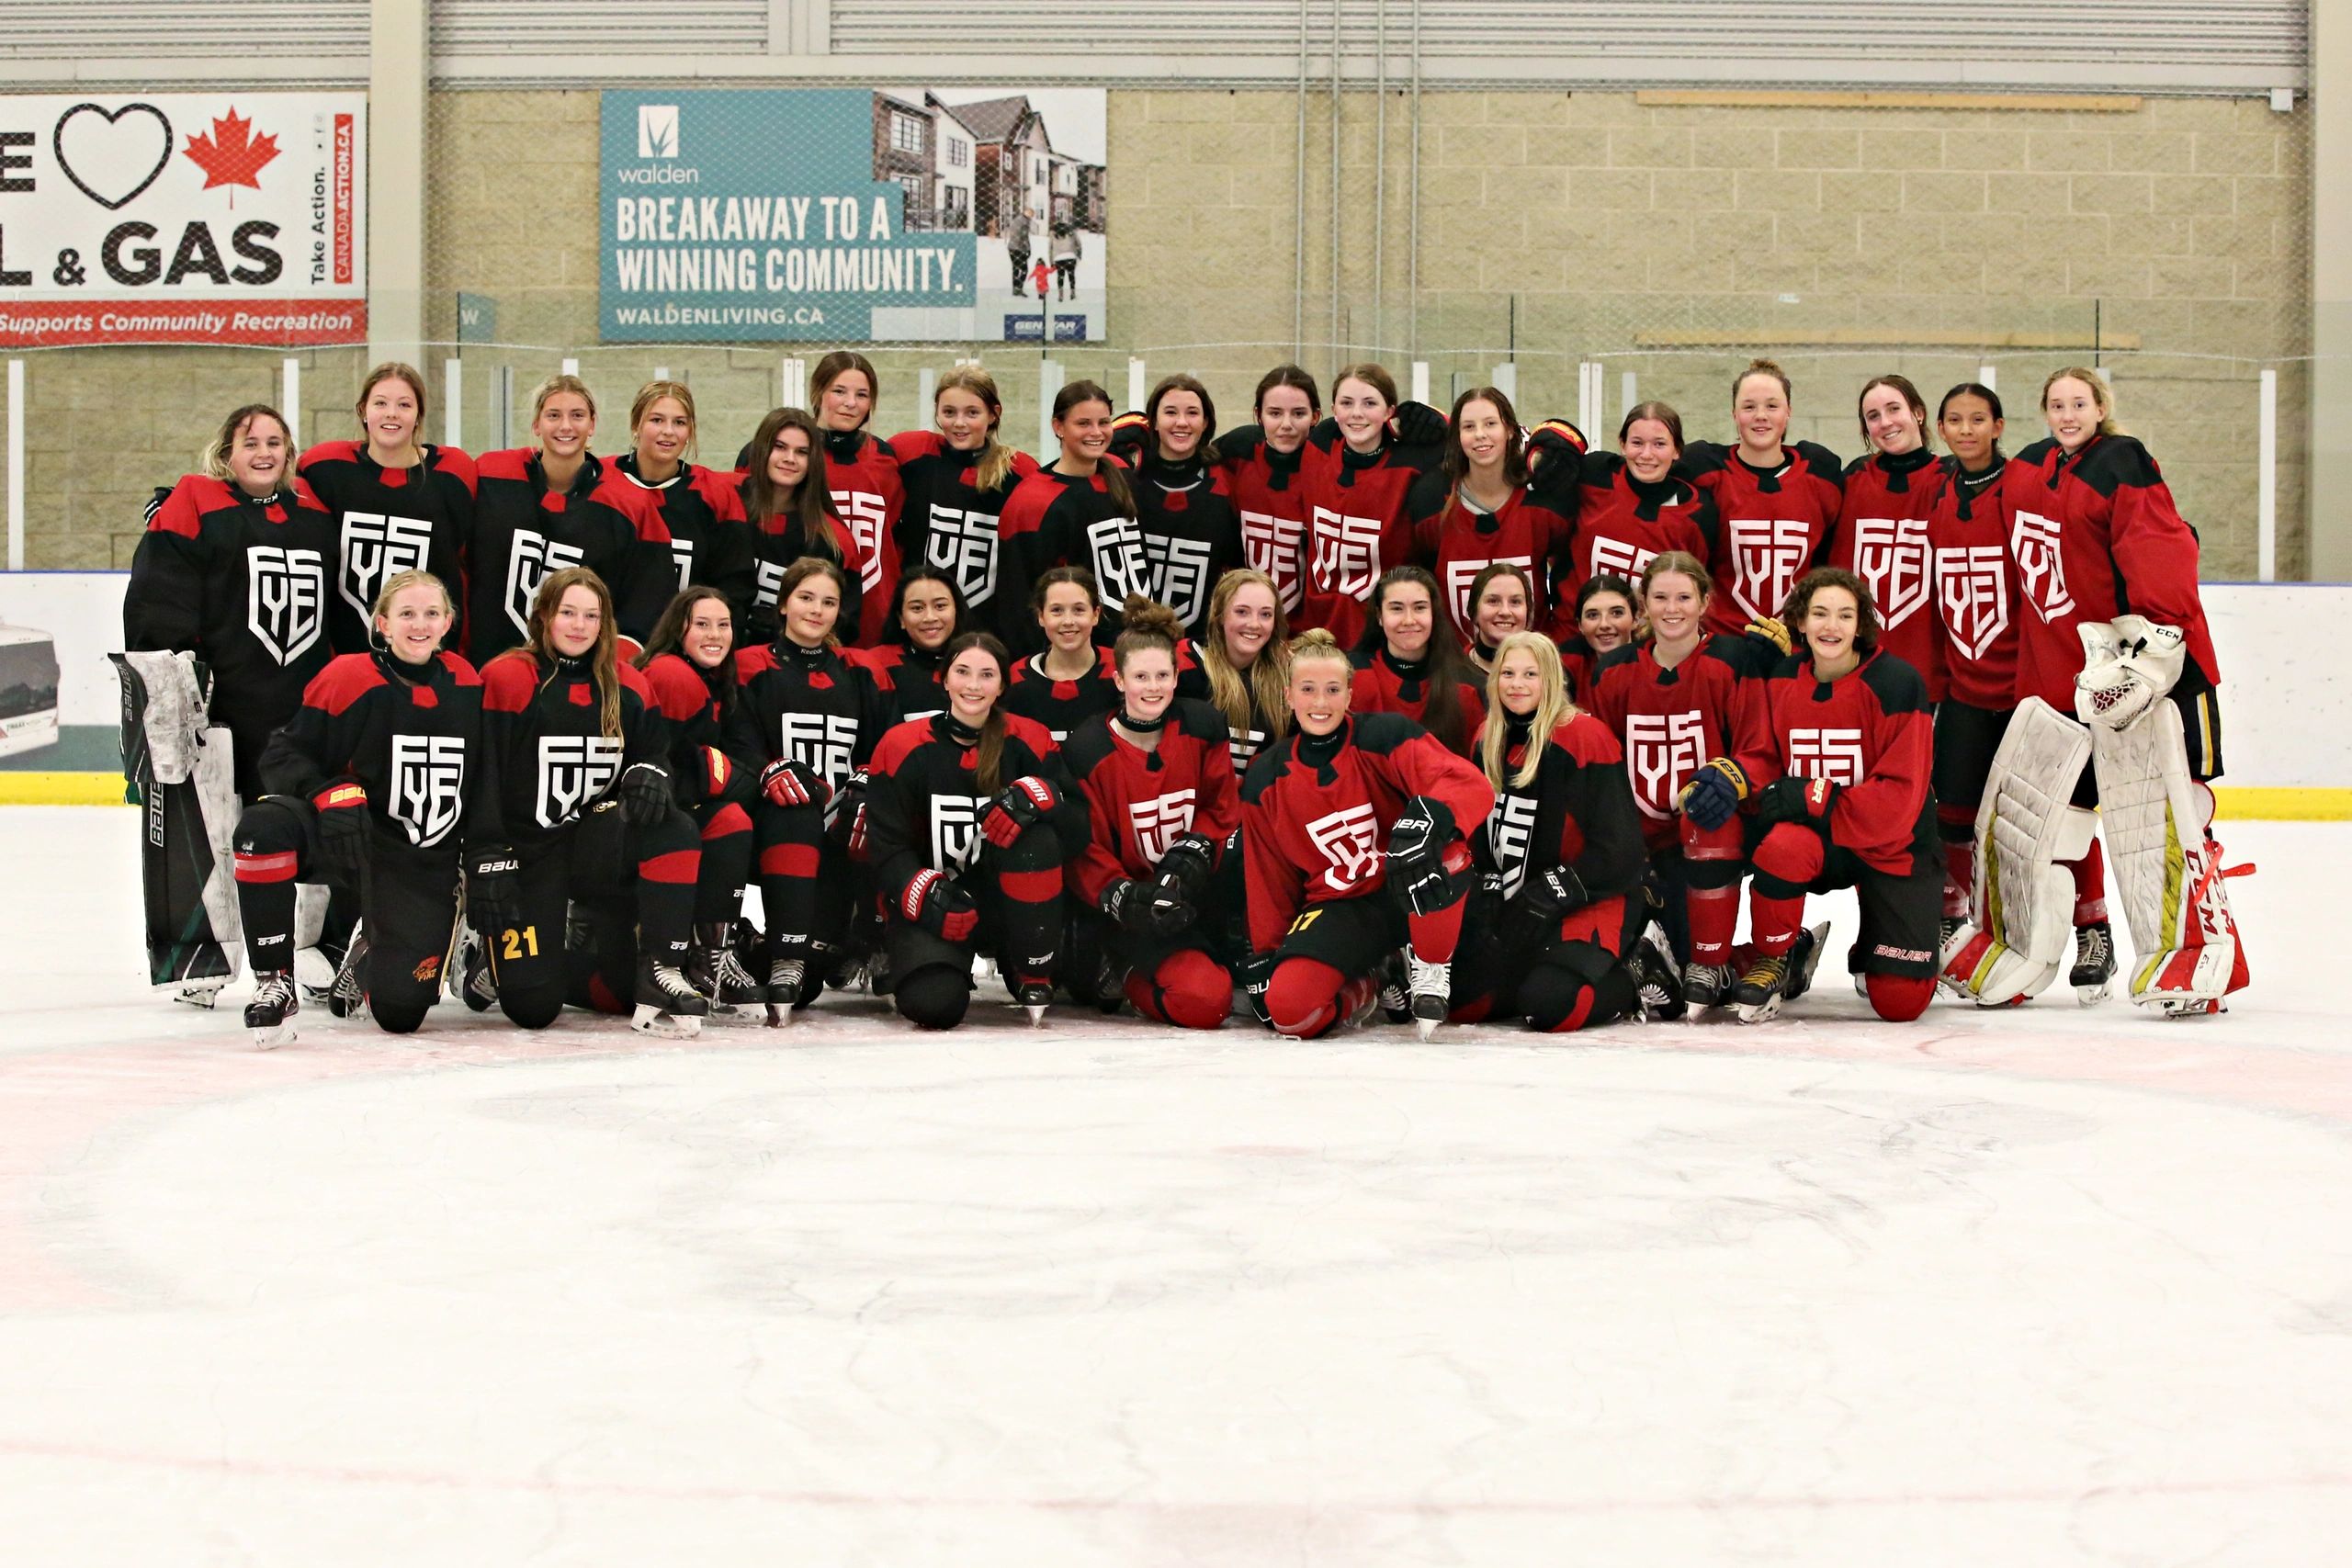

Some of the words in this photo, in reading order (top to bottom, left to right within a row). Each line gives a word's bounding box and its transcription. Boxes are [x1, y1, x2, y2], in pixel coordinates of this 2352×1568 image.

[617, 163, 698, 185] walden
[312, 166, 326, 234] Action.
[336, 123, 352, 280] CANADAACTION.CA
[617, 196, 810, 242] BREAKAWAY
[820, 196, 859, 241] TO
[869, 196, 891, 241] A
[53, 248, 86, 287] &
[102, 220, 283, 287] GAS
[312, 241, 326, 285] Take
[616, 248, 756, 293] WINNING
[764, 248, 964, 293] COMMUNITY.
[0, 314, 93, 335] Supports
[99, 313, 227, 334] Community
[232, 311, 353, 332] Recreation
[616, 307, 825, 326] WALDENLIVING.CA
[2155, 628, 2180, 640] CCM
[800, 648, 823, 656] Reebok
[329, 786, 368, 805] BAU
[478, 859, 519, 874] BAU
[906, 868, 943, 918] WARRIO
[502, 926, 539, 959] 21
[1873, 944, 1932, 963] BAUER
